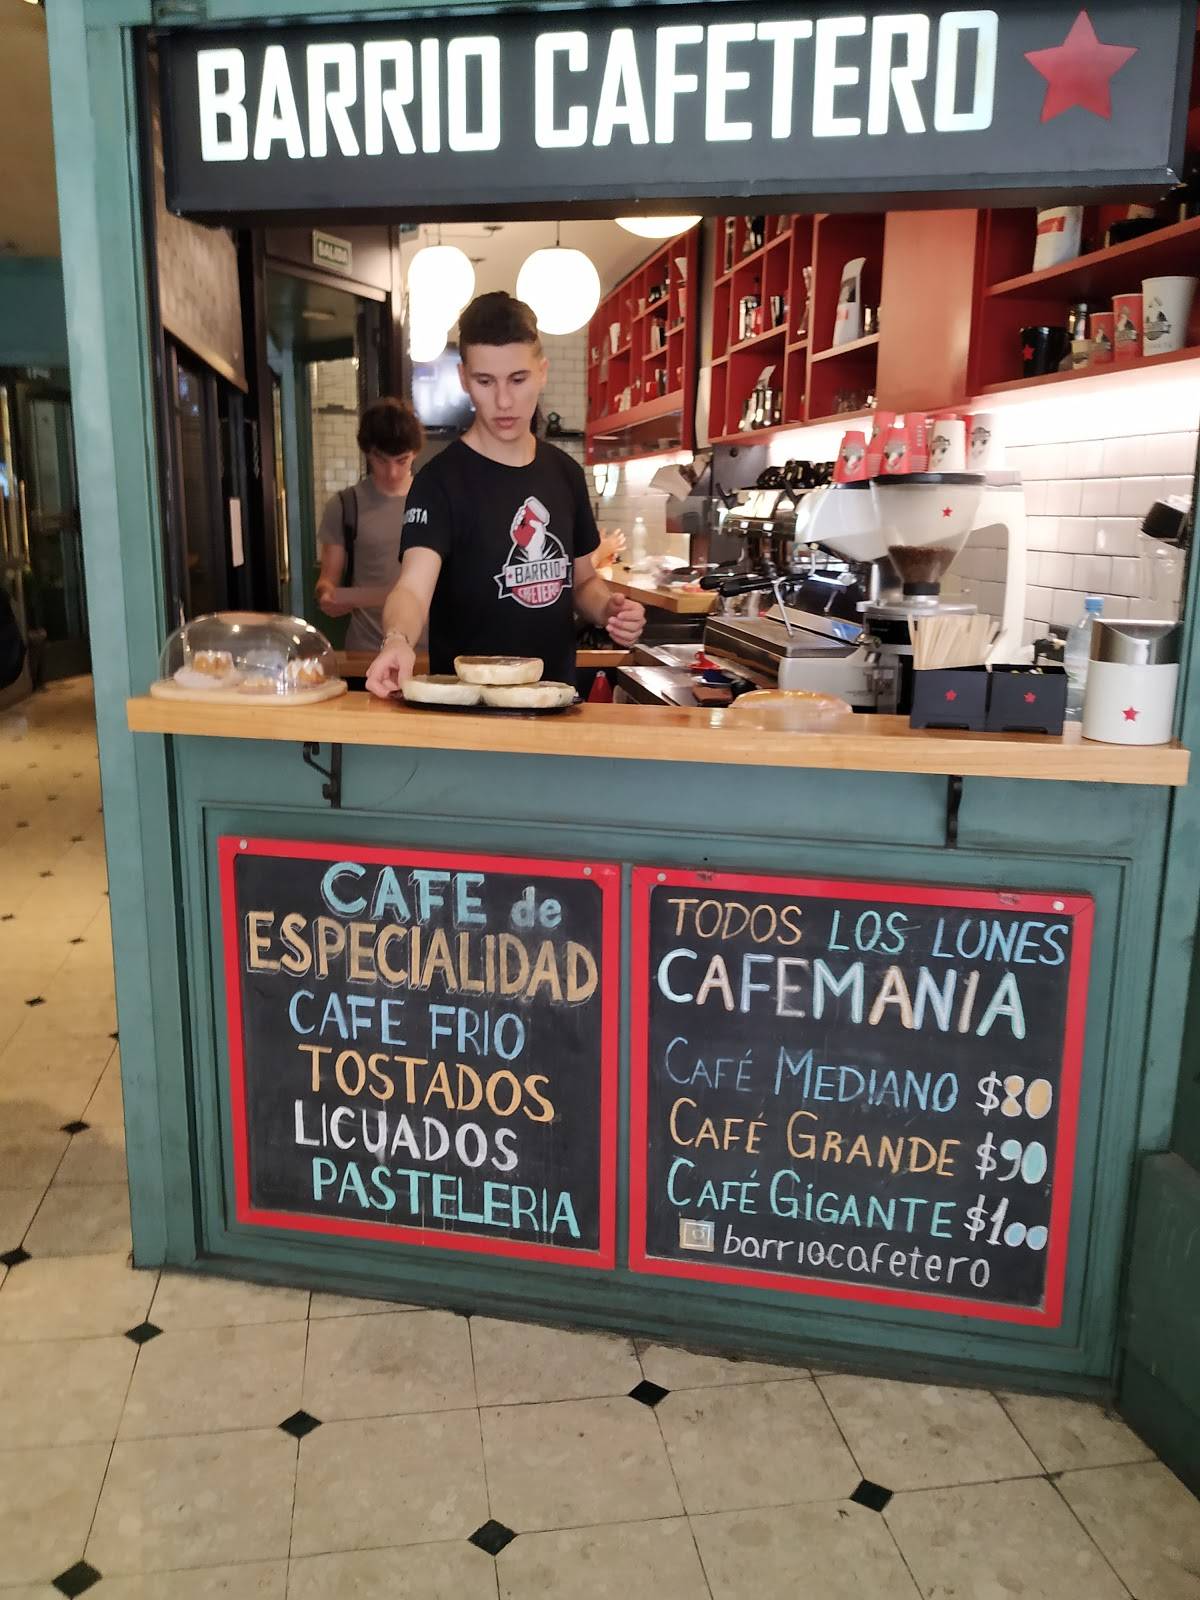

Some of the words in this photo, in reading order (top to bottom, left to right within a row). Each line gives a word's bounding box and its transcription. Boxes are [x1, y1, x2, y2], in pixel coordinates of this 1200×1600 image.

[197, 36, 500, 161] BARRIO
[535, 10, 999, 148] CAFETERO
[515, 561, 561, 584] BARRIO
[320, 862, 487, 929] CAFE
[511, 886, 562, 928] de
[245, 911, 599, 1006] ESPECIALIDAD
[667, 898, 803, 945] TODOS
[828, 909, 910, 953] LOS
[932, 917, 1069, 966] LUNES
[289, 990, 407, 1046] CAFE
[429, 1004, 525, 1060] FRIO
[657, 948, 1026, 1040] CAFEMANIA
[298, 1044, 555, 1122] TOSTADOS
[775, 1046, 959, 1113] MEDIANO
[976, 1070, 1053, 1119] $80
[295, 1099, 518, 1171] LICUADOS
[787, 1110, 961, 1177] GRANDE
[975, 1131, 1047, 1185] $90
[312, 1157, 581, 1238] PASTELERIA
[963, 1194, 1048, 1251] $100
[722, 1224, 991, 1289] barriocafetero
